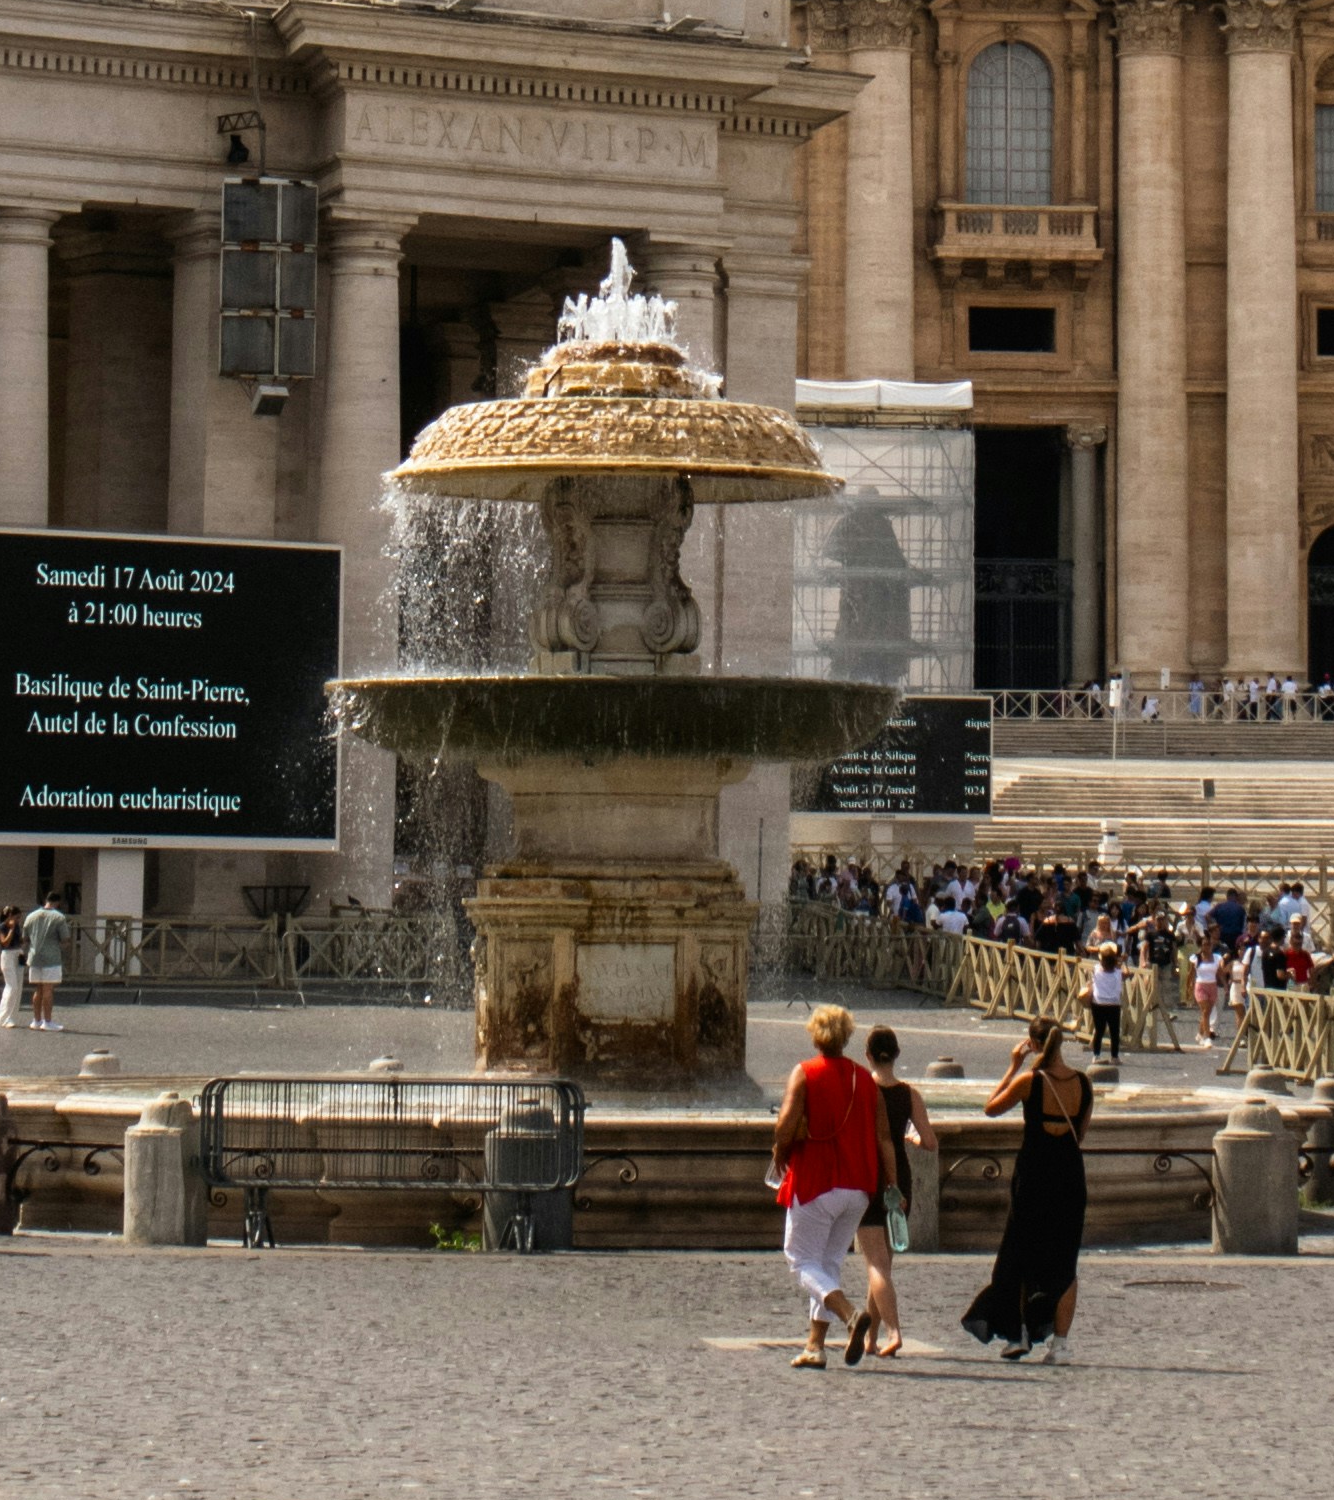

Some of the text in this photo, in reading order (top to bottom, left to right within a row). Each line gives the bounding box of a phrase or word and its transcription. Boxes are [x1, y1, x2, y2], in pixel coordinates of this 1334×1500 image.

[351, 104, 712, 170] ALEXAN VII P M
[36, 563, 235, 594] Samedi 17 Août 2024
[68, 601, 202, 629] à 21:00 heures
[15, 672, 251, 706] Basilique de Saint-Pierre,
[27, 711, 237, 740] Autel de la Confession
[19, 784, 241, 818] Adoration eucharistique
